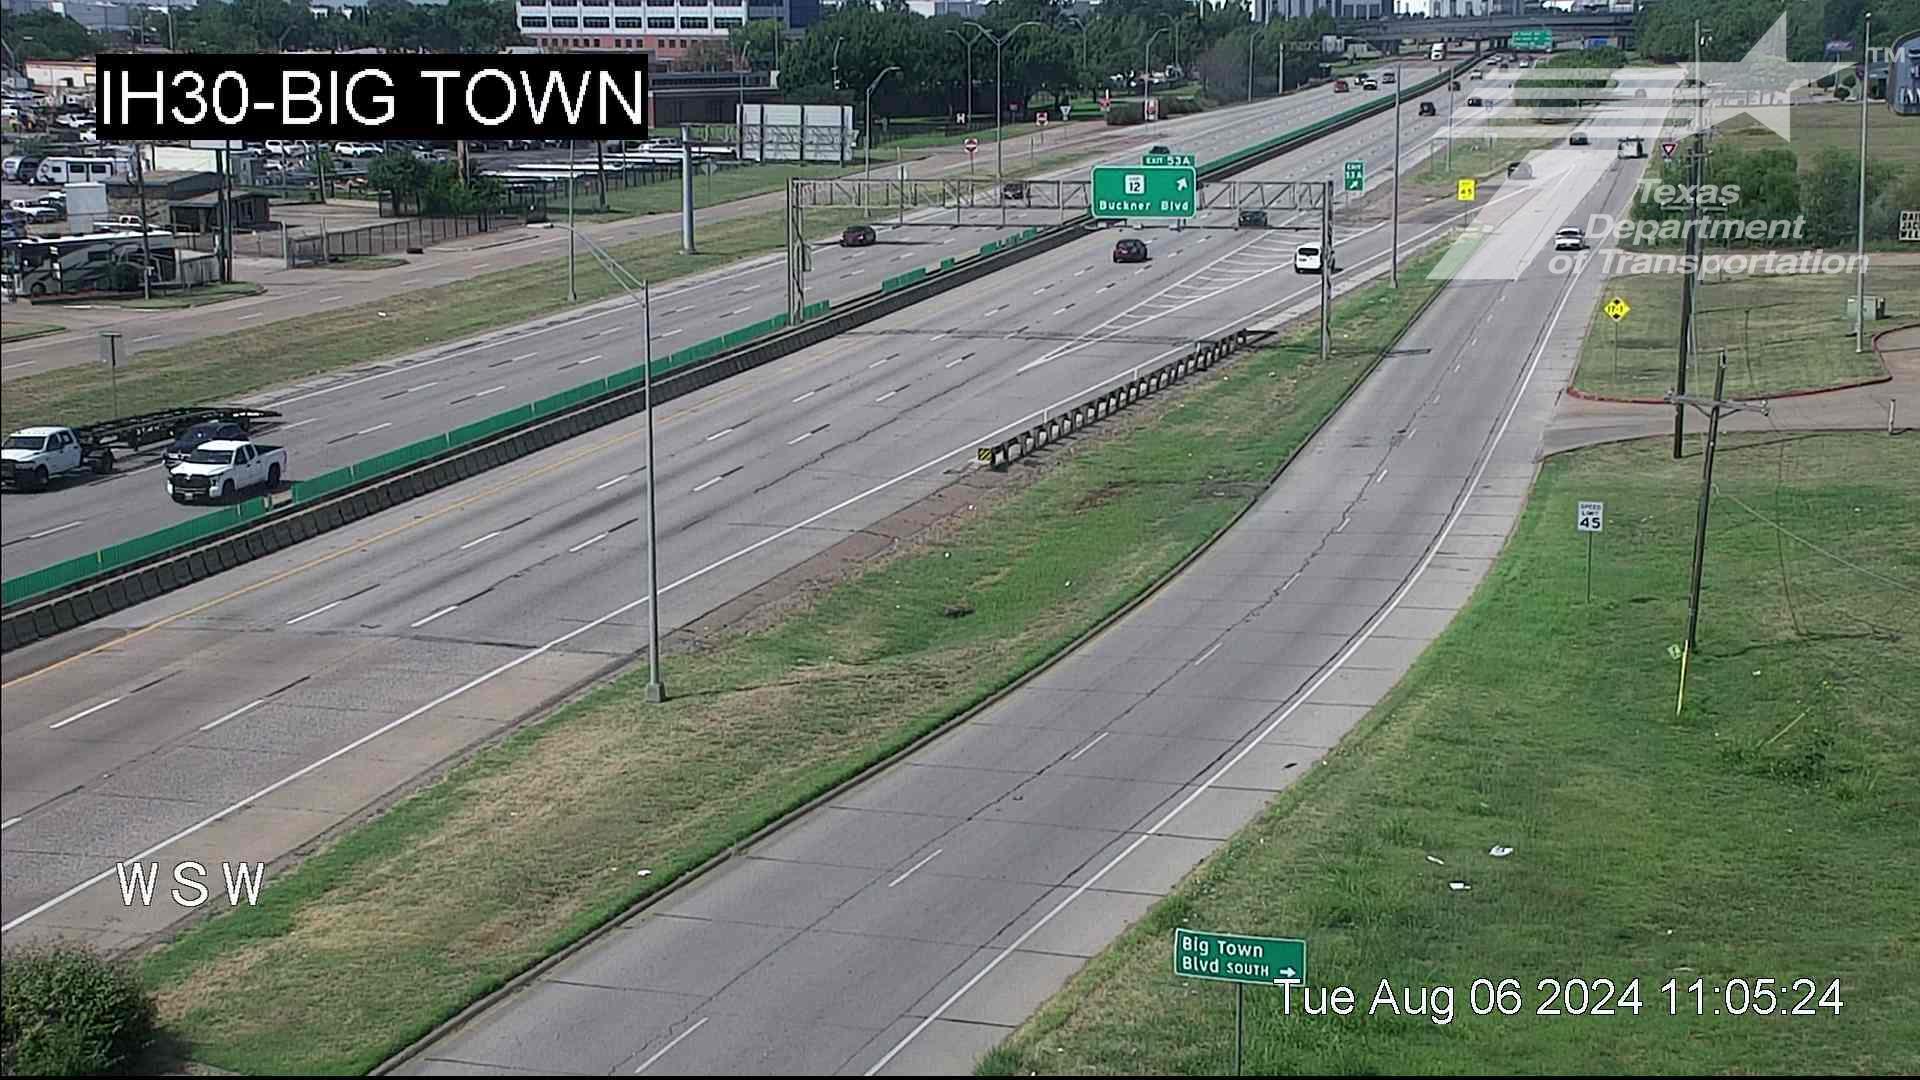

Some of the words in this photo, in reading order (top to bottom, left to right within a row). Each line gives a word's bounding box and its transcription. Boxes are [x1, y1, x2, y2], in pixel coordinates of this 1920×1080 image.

[1167, 156, 1191, 165] 53A
[1129, 181, 1141, 192] 12
[1099, 200, 1151, 211] Buckner
[1161, 200, 1190, 211] Blvd
[1580, 516, 1601, 529] 45
[1182, 936, 1209, 956] Big
[1217, 940, 1263, 958] Town
[1182, 956, 1219, 973] Blvd
[1226, 962, 1269, 977] SOUTH
